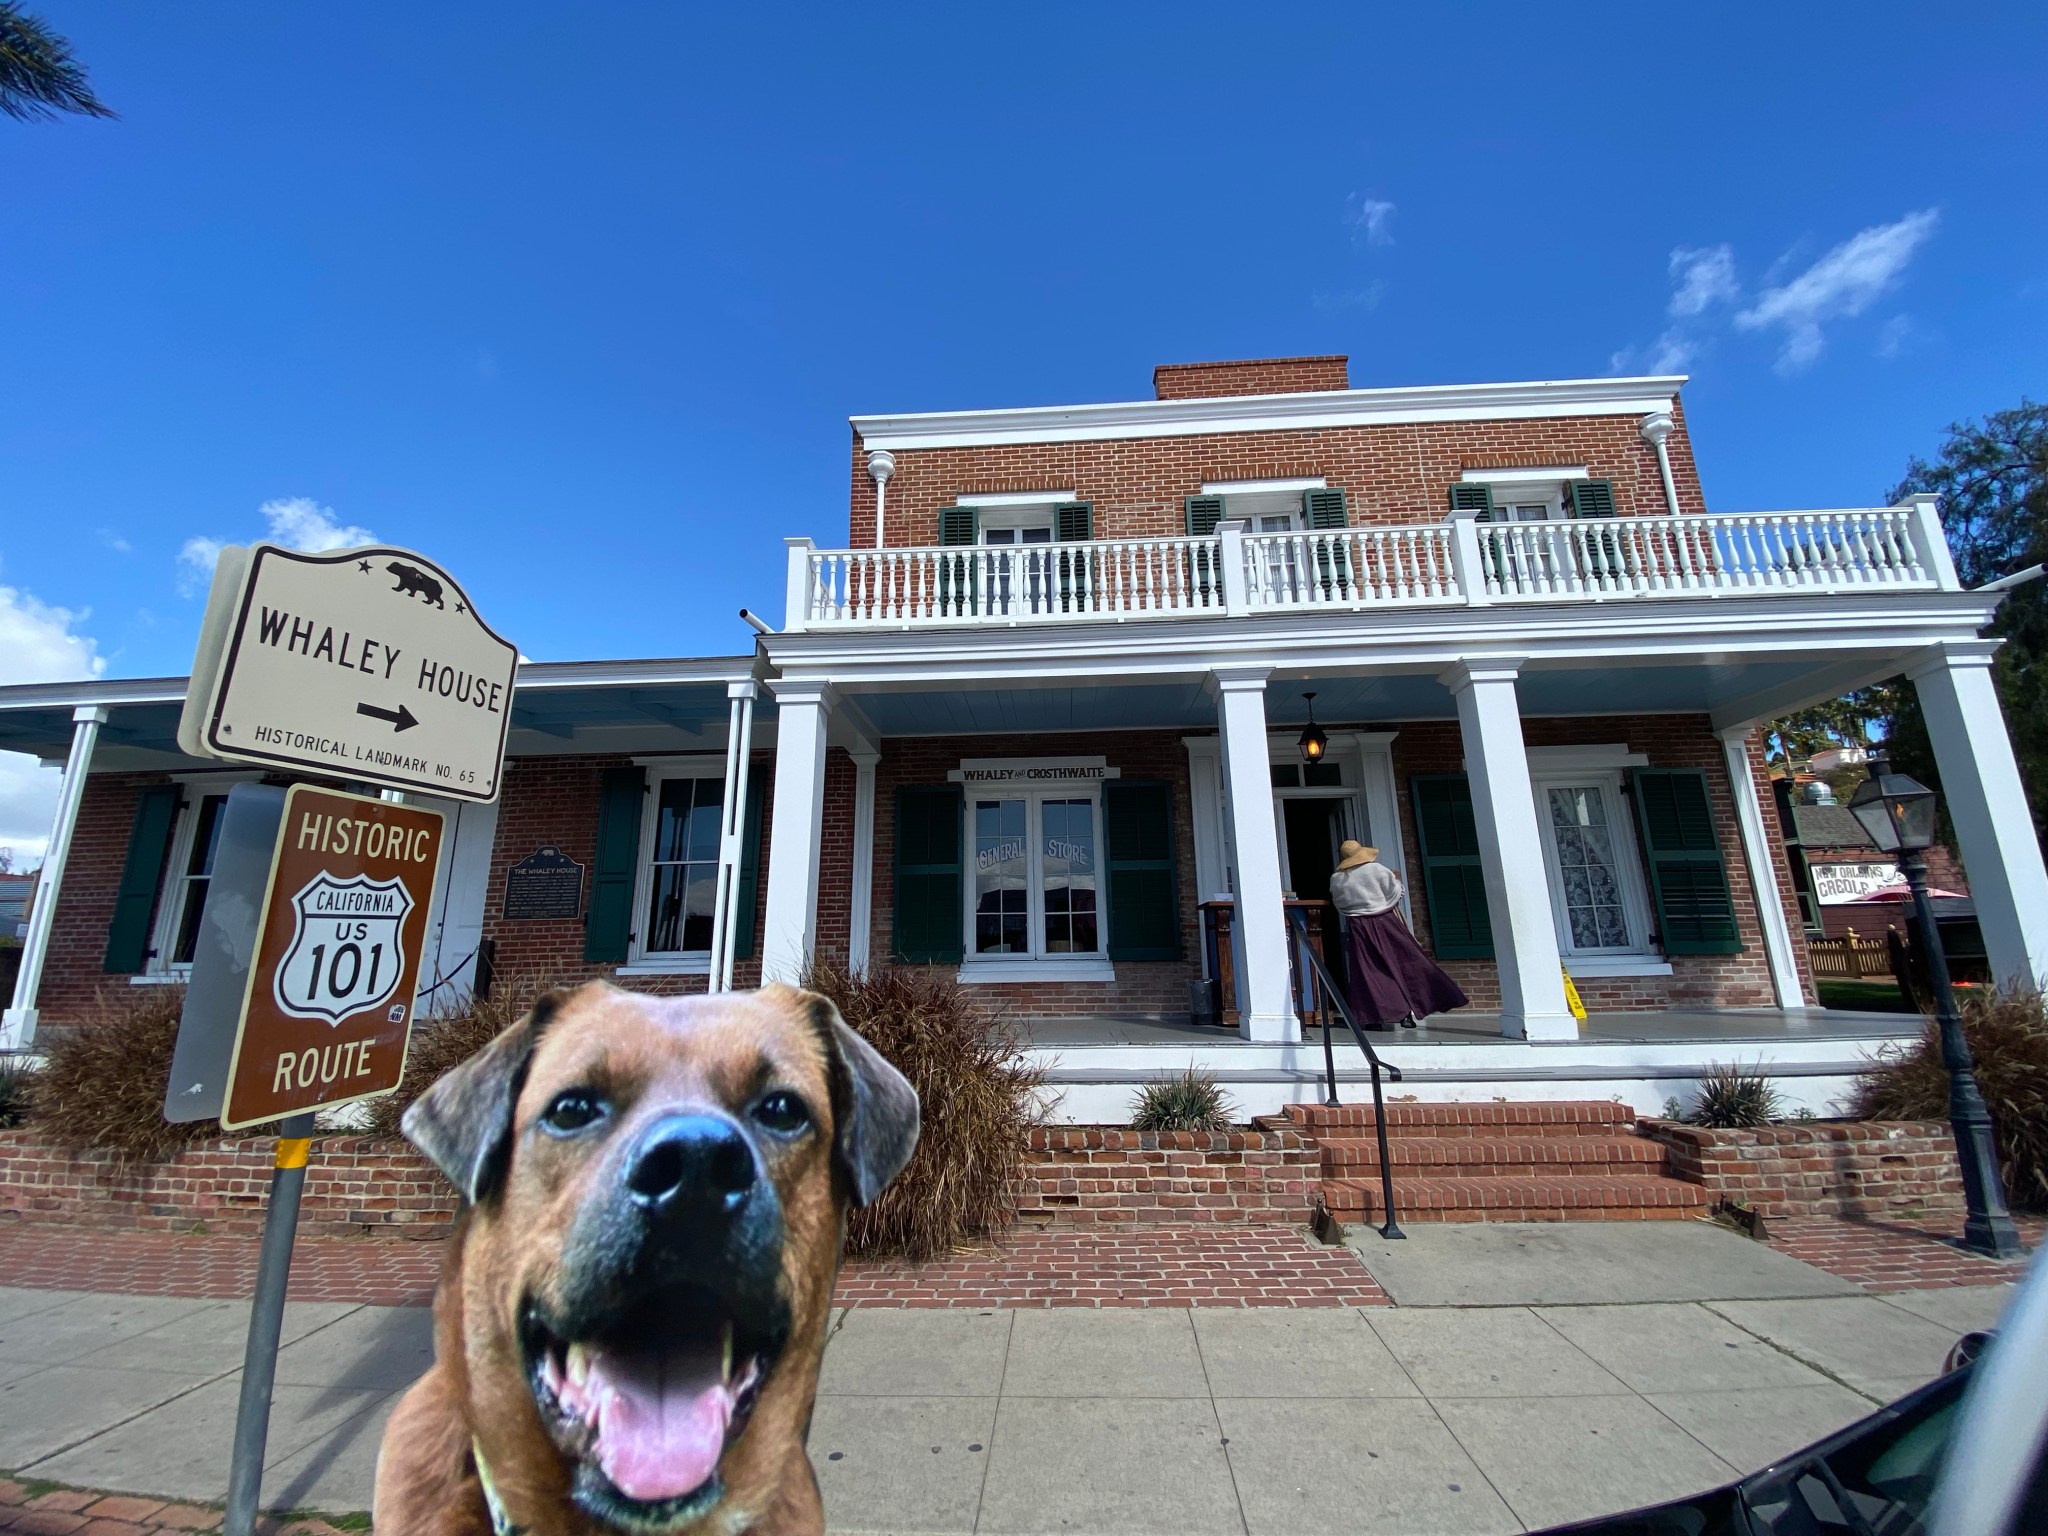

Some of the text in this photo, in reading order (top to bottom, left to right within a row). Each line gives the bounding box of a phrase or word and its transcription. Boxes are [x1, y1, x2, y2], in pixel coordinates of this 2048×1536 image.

[260, 606, 503, 713] WHALEY HOUSE
[255, 725, 475, 783] HISTORICAL LANDMARK NO. 65
[963, 769, 1014, 780] WHALEY
[1026, 767, 1105, 779] CROSTHWAITE
[297, 811, 430, 863] HISTORIC
[978, 838, 1087, 870] GENERAL STORE
[1815, 866, 1883, 879] NEW ORLEANS
[1818, 879, 1870, 897] CREOLE
[316, 890, 393, 913] CALIFORNIA
[335, 922, 368, 941] US
[307, 942, 383, 1001] 101
[272, 1038, 376, 1093] ROUTE
